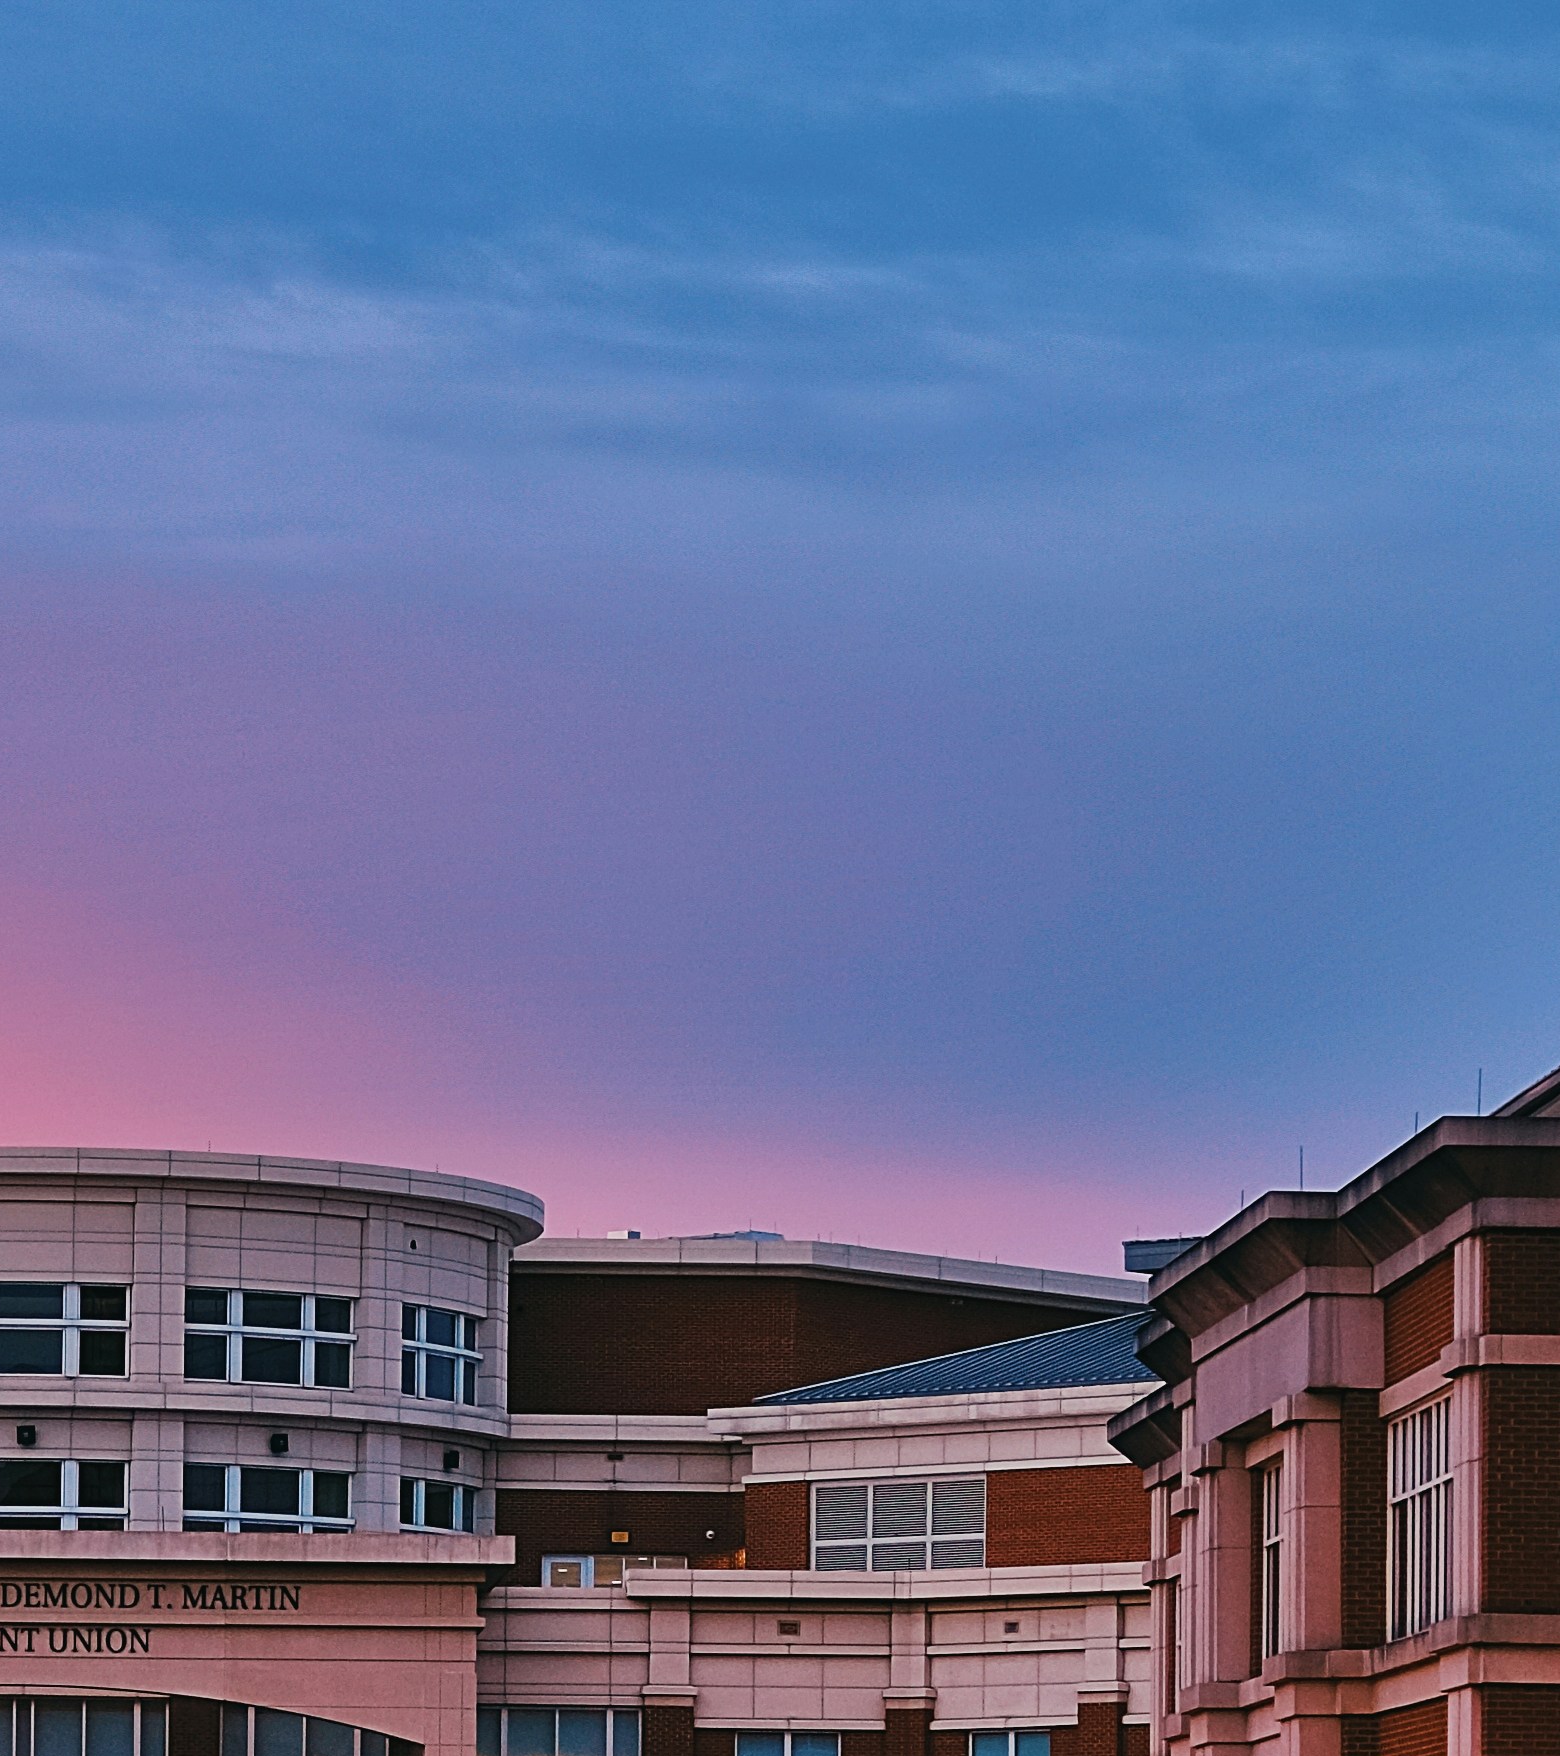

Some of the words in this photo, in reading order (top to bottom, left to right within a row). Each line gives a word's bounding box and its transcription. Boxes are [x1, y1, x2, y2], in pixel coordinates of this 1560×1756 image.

[0, 1582, 140, 1609] DEMOND
[147, 1584, 173, 1609] T.
[181, 1585, 301, 1611] MARTIN
[48, 1628, 151, 1653] UNION
